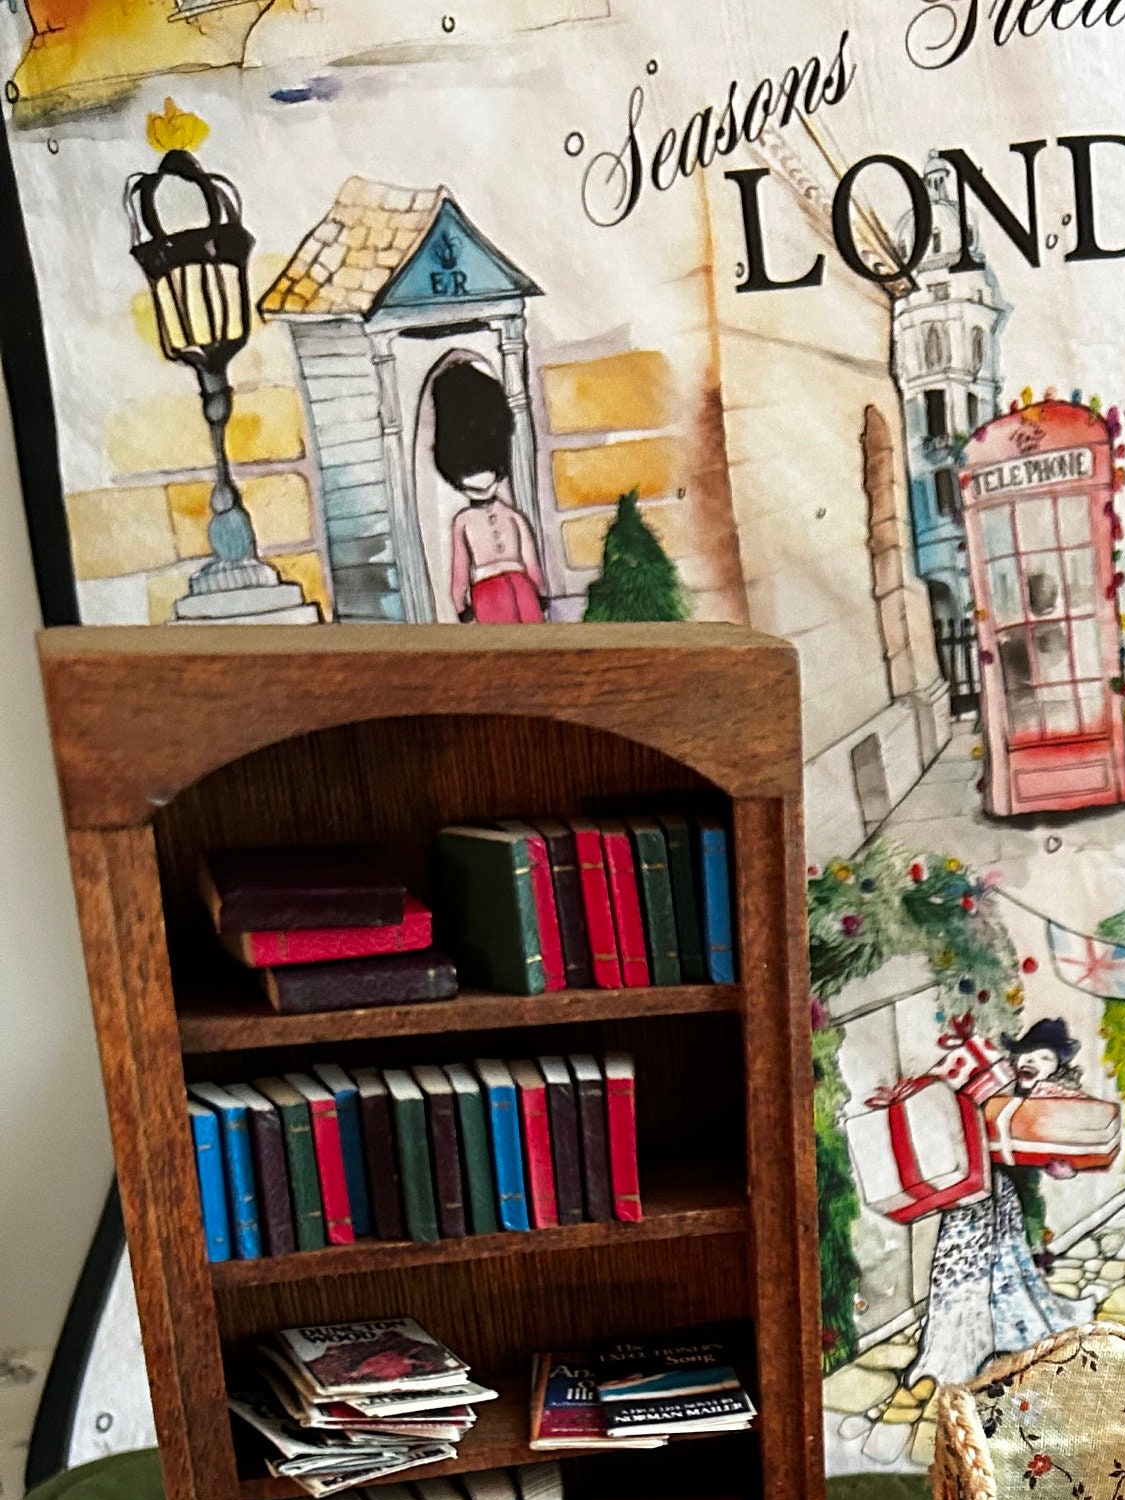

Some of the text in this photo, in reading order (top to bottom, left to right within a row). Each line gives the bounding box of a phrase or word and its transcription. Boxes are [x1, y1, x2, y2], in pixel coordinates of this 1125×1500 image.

[582, 29, 859, 227] Seasons
[429, 271, 470, 295] ER
[971, 451, 1088, 495] TELEPHONE
[304, 1331, 377, 1344] WOOD
[614, 1402, 744, 1423] NORMAN MAILER
